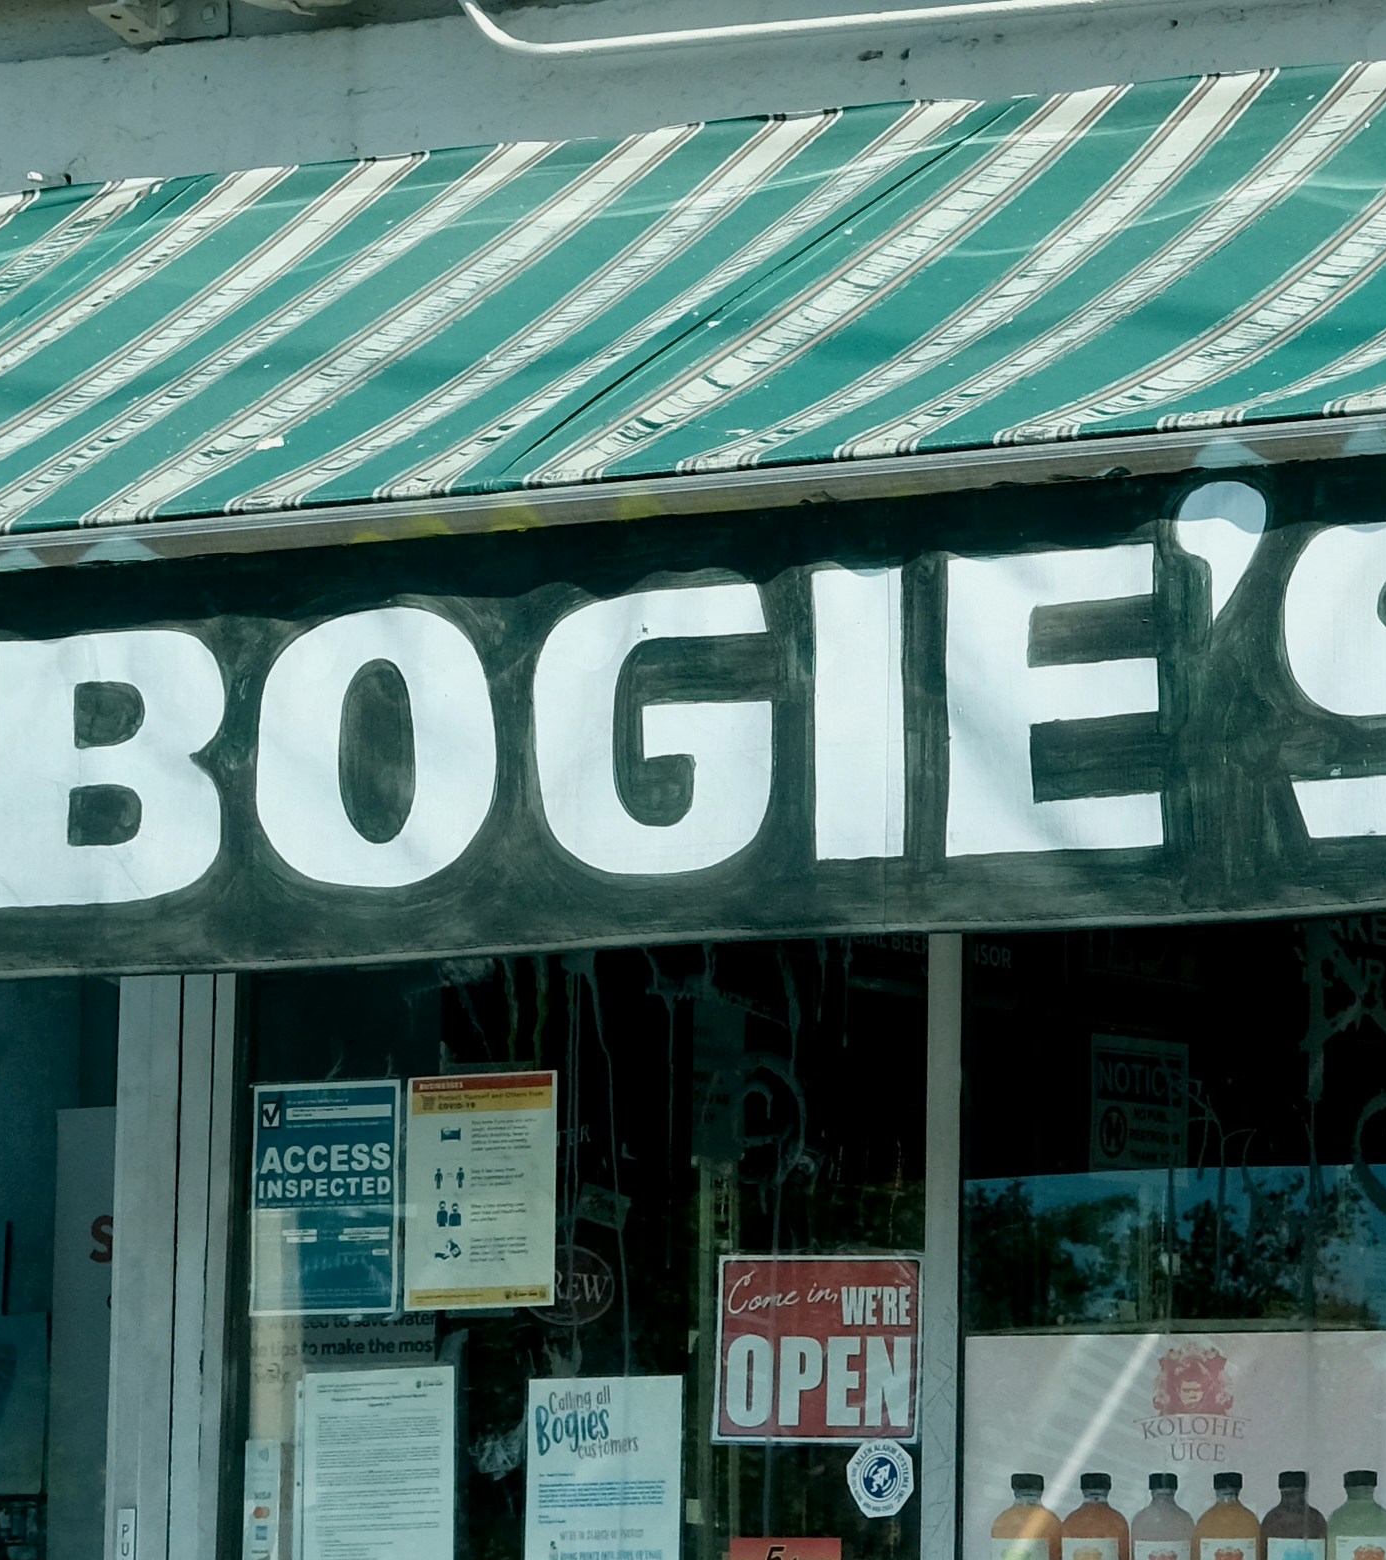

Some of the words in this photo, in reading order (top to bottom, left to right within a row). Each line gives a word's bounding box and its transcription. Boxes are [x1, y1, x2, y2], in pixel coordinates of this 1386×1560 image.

[260, 1143, 391, 1174] ACCESS
[258, 1176, 391, 1199] INSPECTED
[727, 1271, 798, 1315] Come
[841, 1286, 911, 1326] WE'RE
[321, 1338, 365, 1355] make
[368, 1338, 395, 1353] the
[725, 1335, 912, 1427] OPEN
[549, 1390, 592, 1415] Calling
[597, 1385, 611, 1406] all
[535, 1405, 609, 1456] Bogies
[1141, 1416, 1246, 1440] KOLOHE
[578, 1436, 639, 1460] customers
